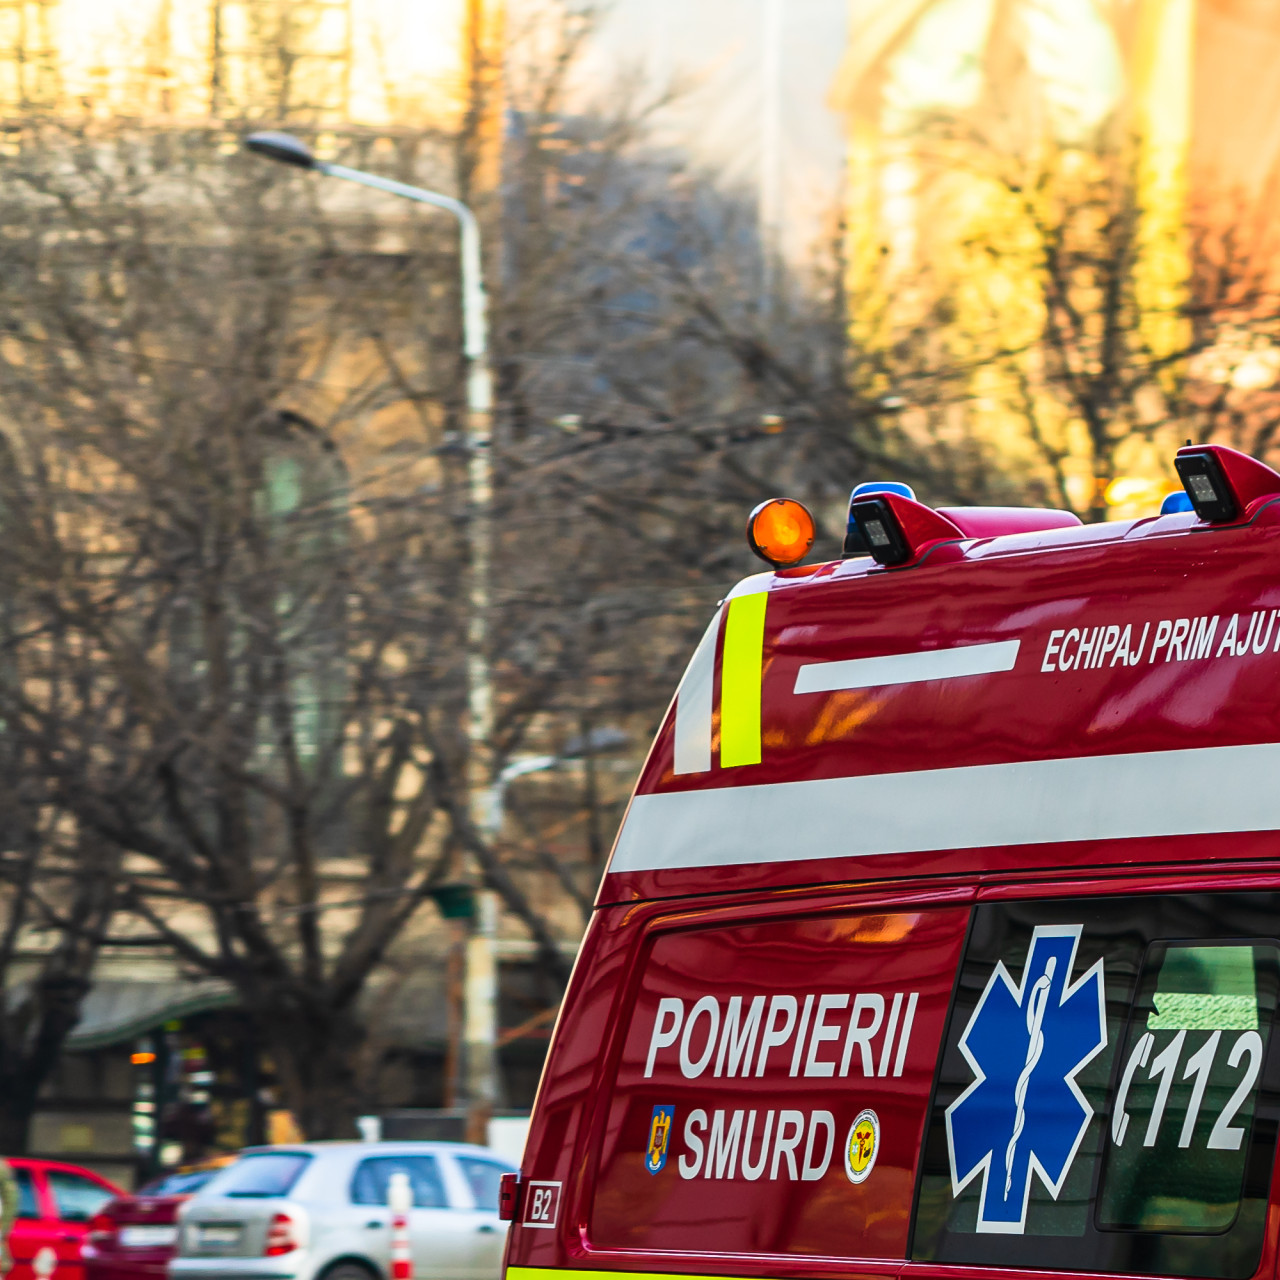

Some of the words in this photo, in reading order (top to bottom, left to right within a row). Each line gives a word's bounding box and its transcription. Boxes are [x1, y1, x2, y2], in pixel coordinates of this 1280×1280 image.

[1041, 621, 1150, 673] ECHIPAJ
[1149, 614, 1220, 664] PRIM
[643, 992, 920, 1079] POMPIERII
[678, 1108, 836, 1181] SMURD
[531, 1188, 552, 1221] B2
